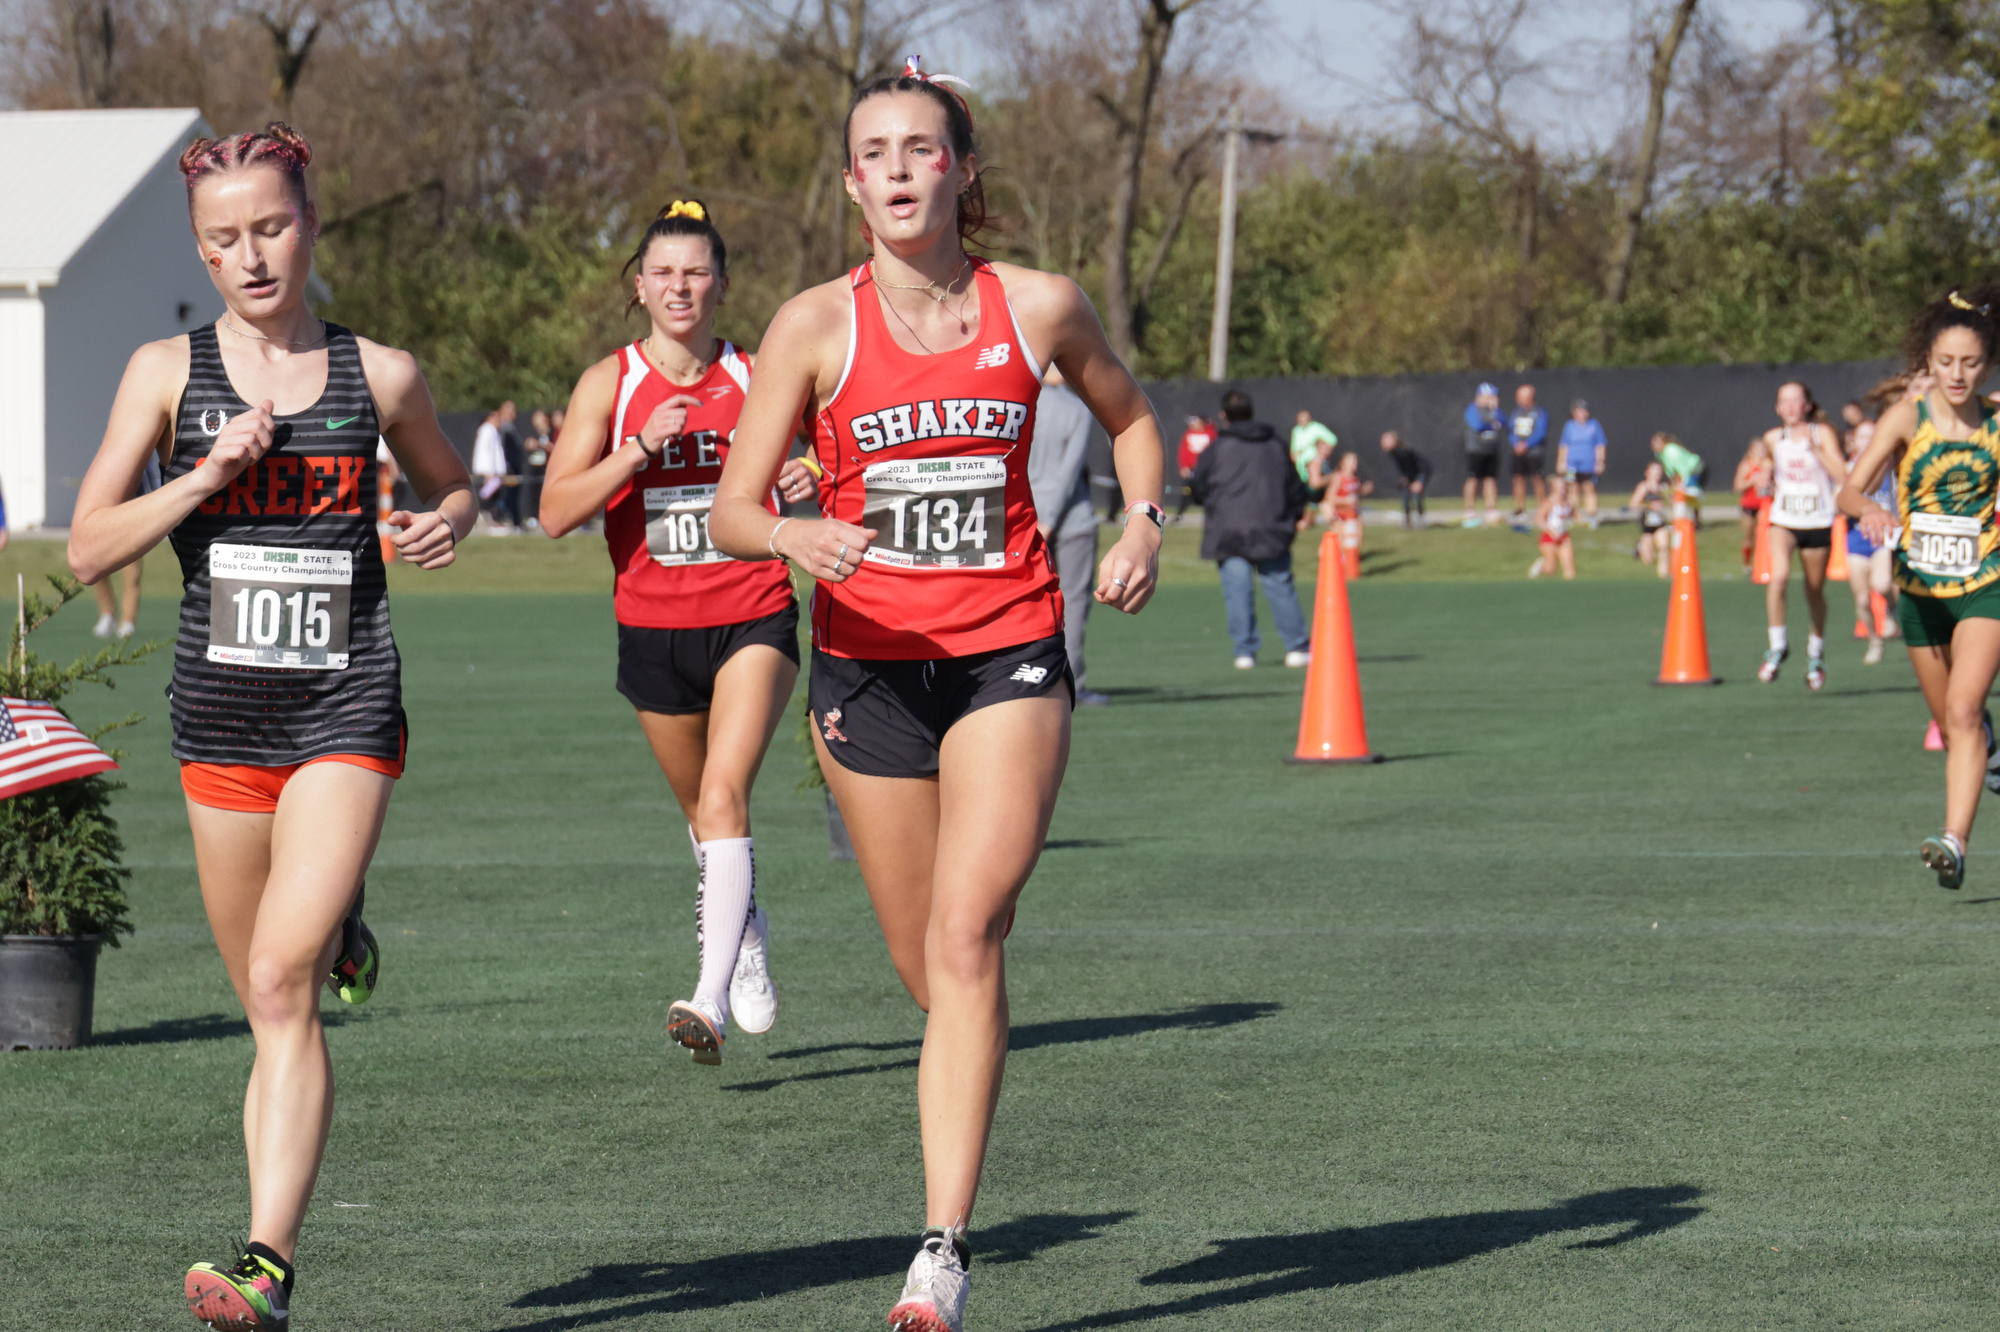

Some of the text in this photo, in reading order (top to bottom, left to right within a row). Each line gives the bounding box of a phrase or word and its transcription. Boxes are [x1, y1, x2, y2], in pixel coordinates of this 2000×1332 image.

[850, 398, 1028, 453] SHAKER
[866, 472, 1004, 485] Cross Country Championships
[887, 461, 986, 474] 2023 OHSAA STATE
[664, 512, 714, 552] 101
[889, 496, 987, 551] 1134
[233, 551, 333, 564] 2023 OHSAA STATE
[1920, 533, 1973, 566] 1050
[212, 561, 351, 576] Cross Country Championships
[233, 588, 331, 647] 1015
